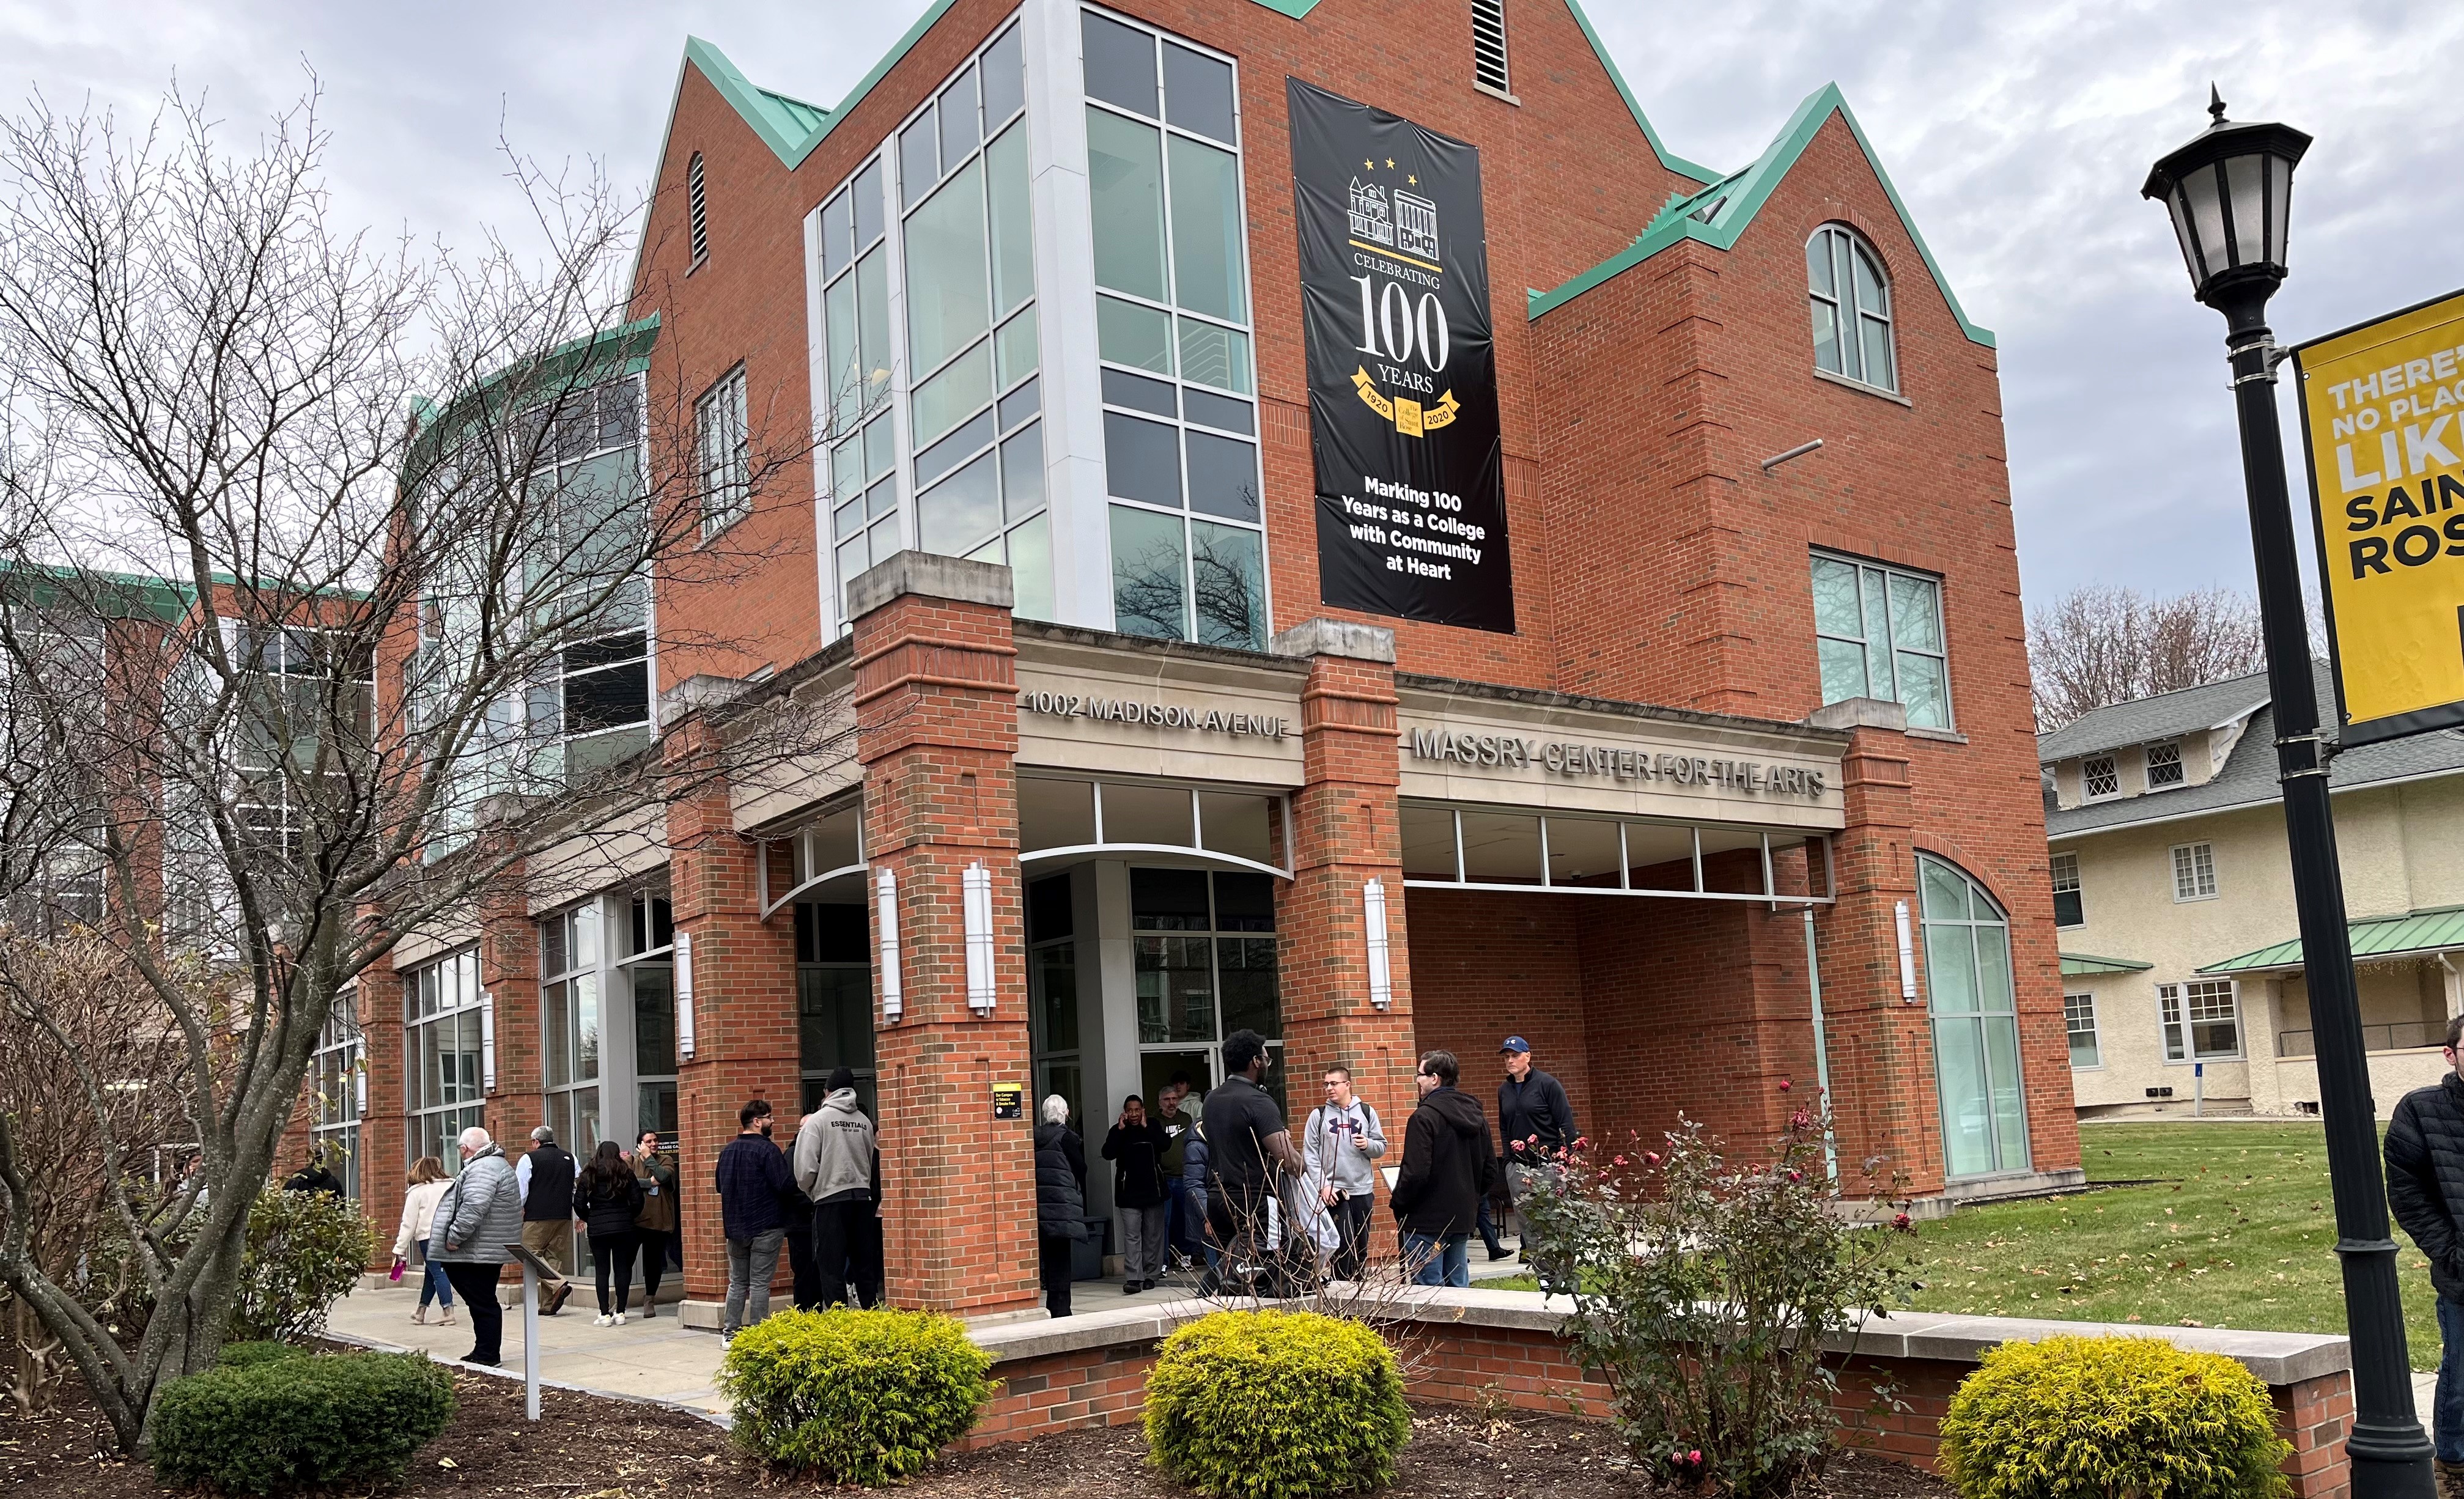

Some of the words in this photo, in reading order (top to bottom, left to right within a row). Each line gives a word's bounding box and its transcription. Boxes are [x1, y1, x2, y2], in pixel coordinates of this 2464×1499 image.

[1354, 252, 1440, 290] CELEBRATING
[1350, 274, 1449, 372] 100
[1378, 363, 1433, 394] YEARS
[1367, 391, 1388, 413] 1920
[1427, 410, 1449, 425] 2020
[2332, 408, 2380, 440] NO
[2336, 410, 2464, 493] LIK
[1365, 476, 1429, 508] Marking
[1433, 492, 1462, 512] 100
[1341, 495, 1388, 520] Years
[1392, 509, 1410, 525] as
[1414, 514, 1423, 528] a
[1427, 514, 1486, 540] College
[1349, 523, 1386, 544] with
[1390, 530, 1481, 565] Community
[1386, 555, 1403, 572] at
[1407, 556, 1451, 580] Heart
[1025, 690, 1082, 717] 1002
[1086, 696, 1198, 729] MADISON
[1203, 709, 1291, 738] AVENUE
[1411, 727, 1536, 768] MASSRY
[1541, 742, 1651, 781] CENTER
[1656, 753, 1711, 786] FOR
[1713, 759, 1763, 790] THE
[1766, 765, 1826, 796] ARTS
[831, 1121, 867, 1130] ESSENTIALS
